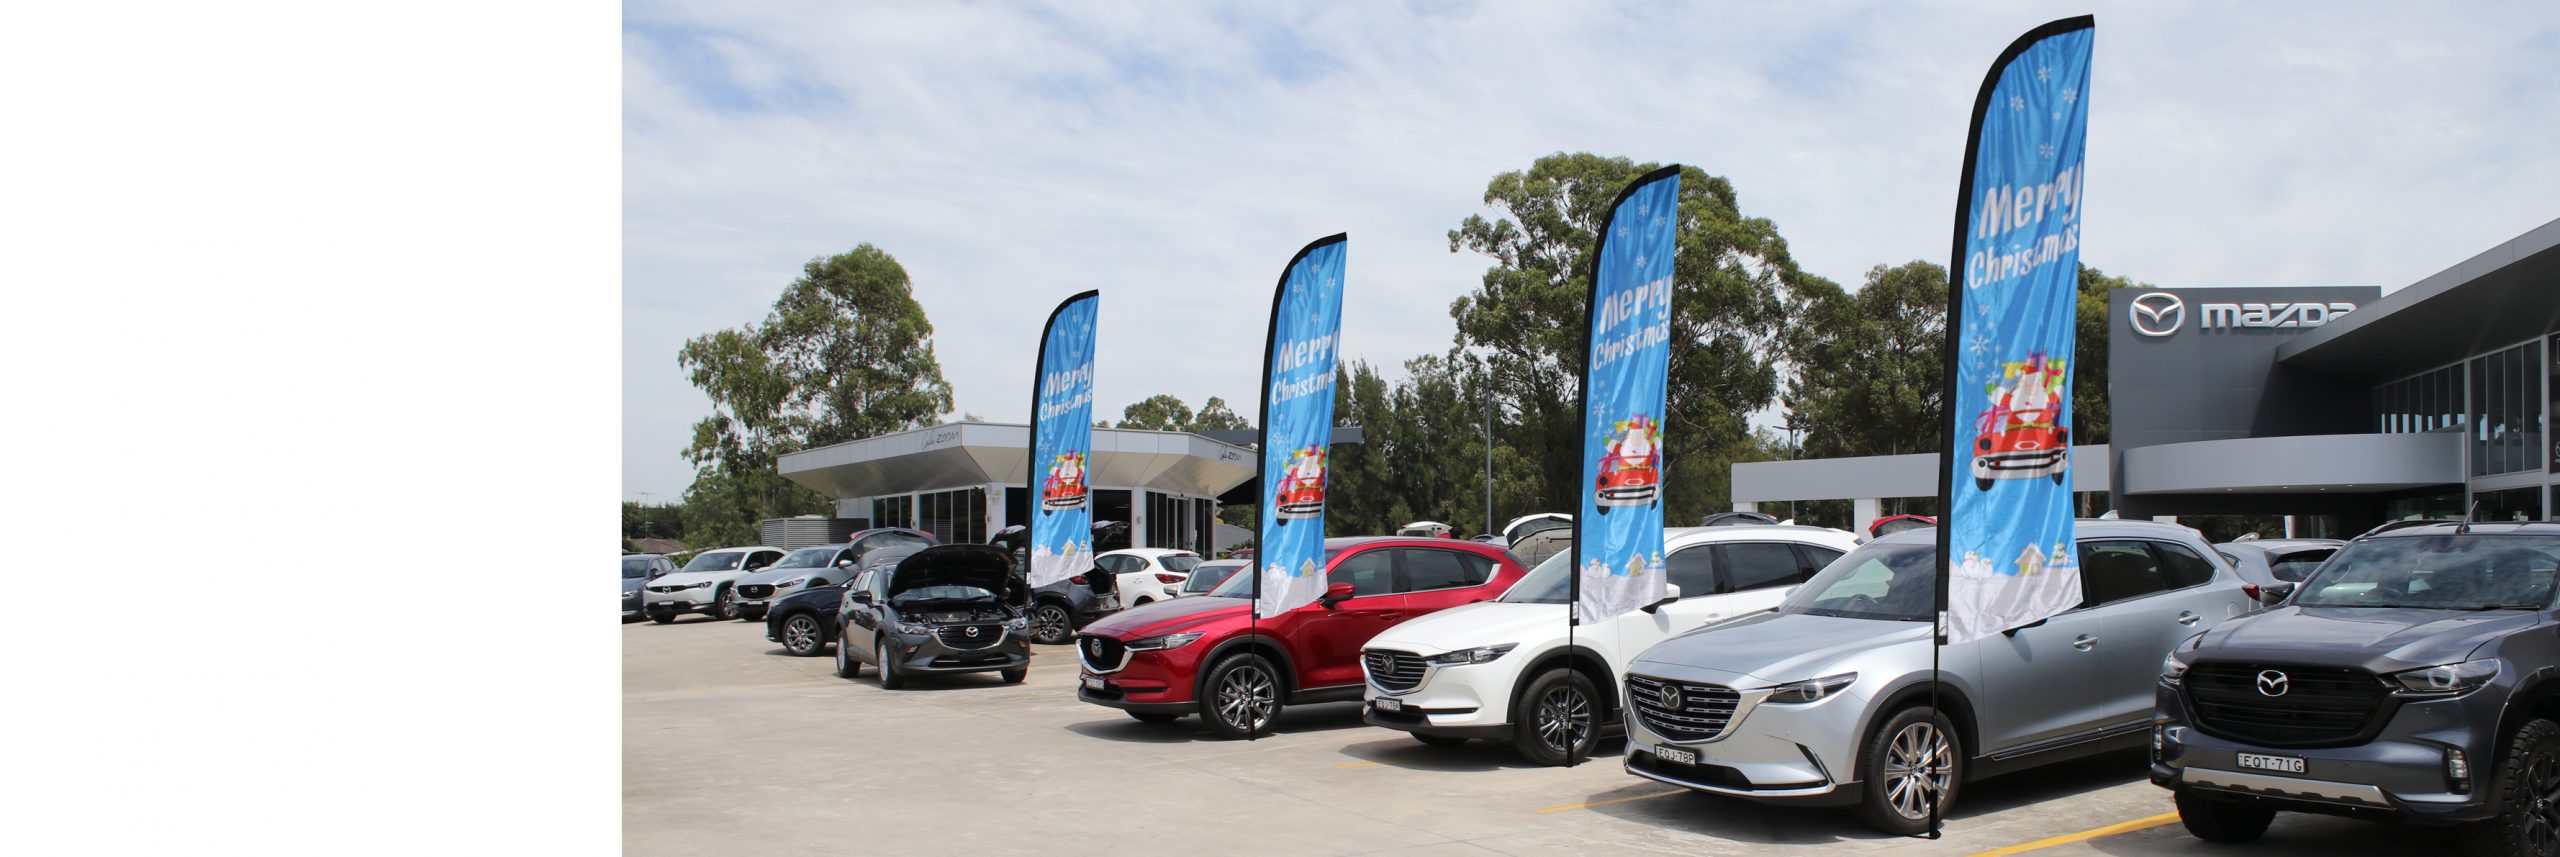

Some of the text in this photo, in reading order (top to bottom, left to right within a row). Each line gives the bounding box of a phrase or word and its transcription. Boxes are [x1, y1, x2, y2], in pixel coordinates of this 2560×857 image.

[1979, 161, 2081, 240] Merry
[1969, 224, 2078, 289] Christmas
[1600, 274, 1672, 334] Merry
[1593, 320, 1669, 370] Christmas
[1040, 389, 1092, 421] Christmas
[1044, 360, 1092, 398] Merry
